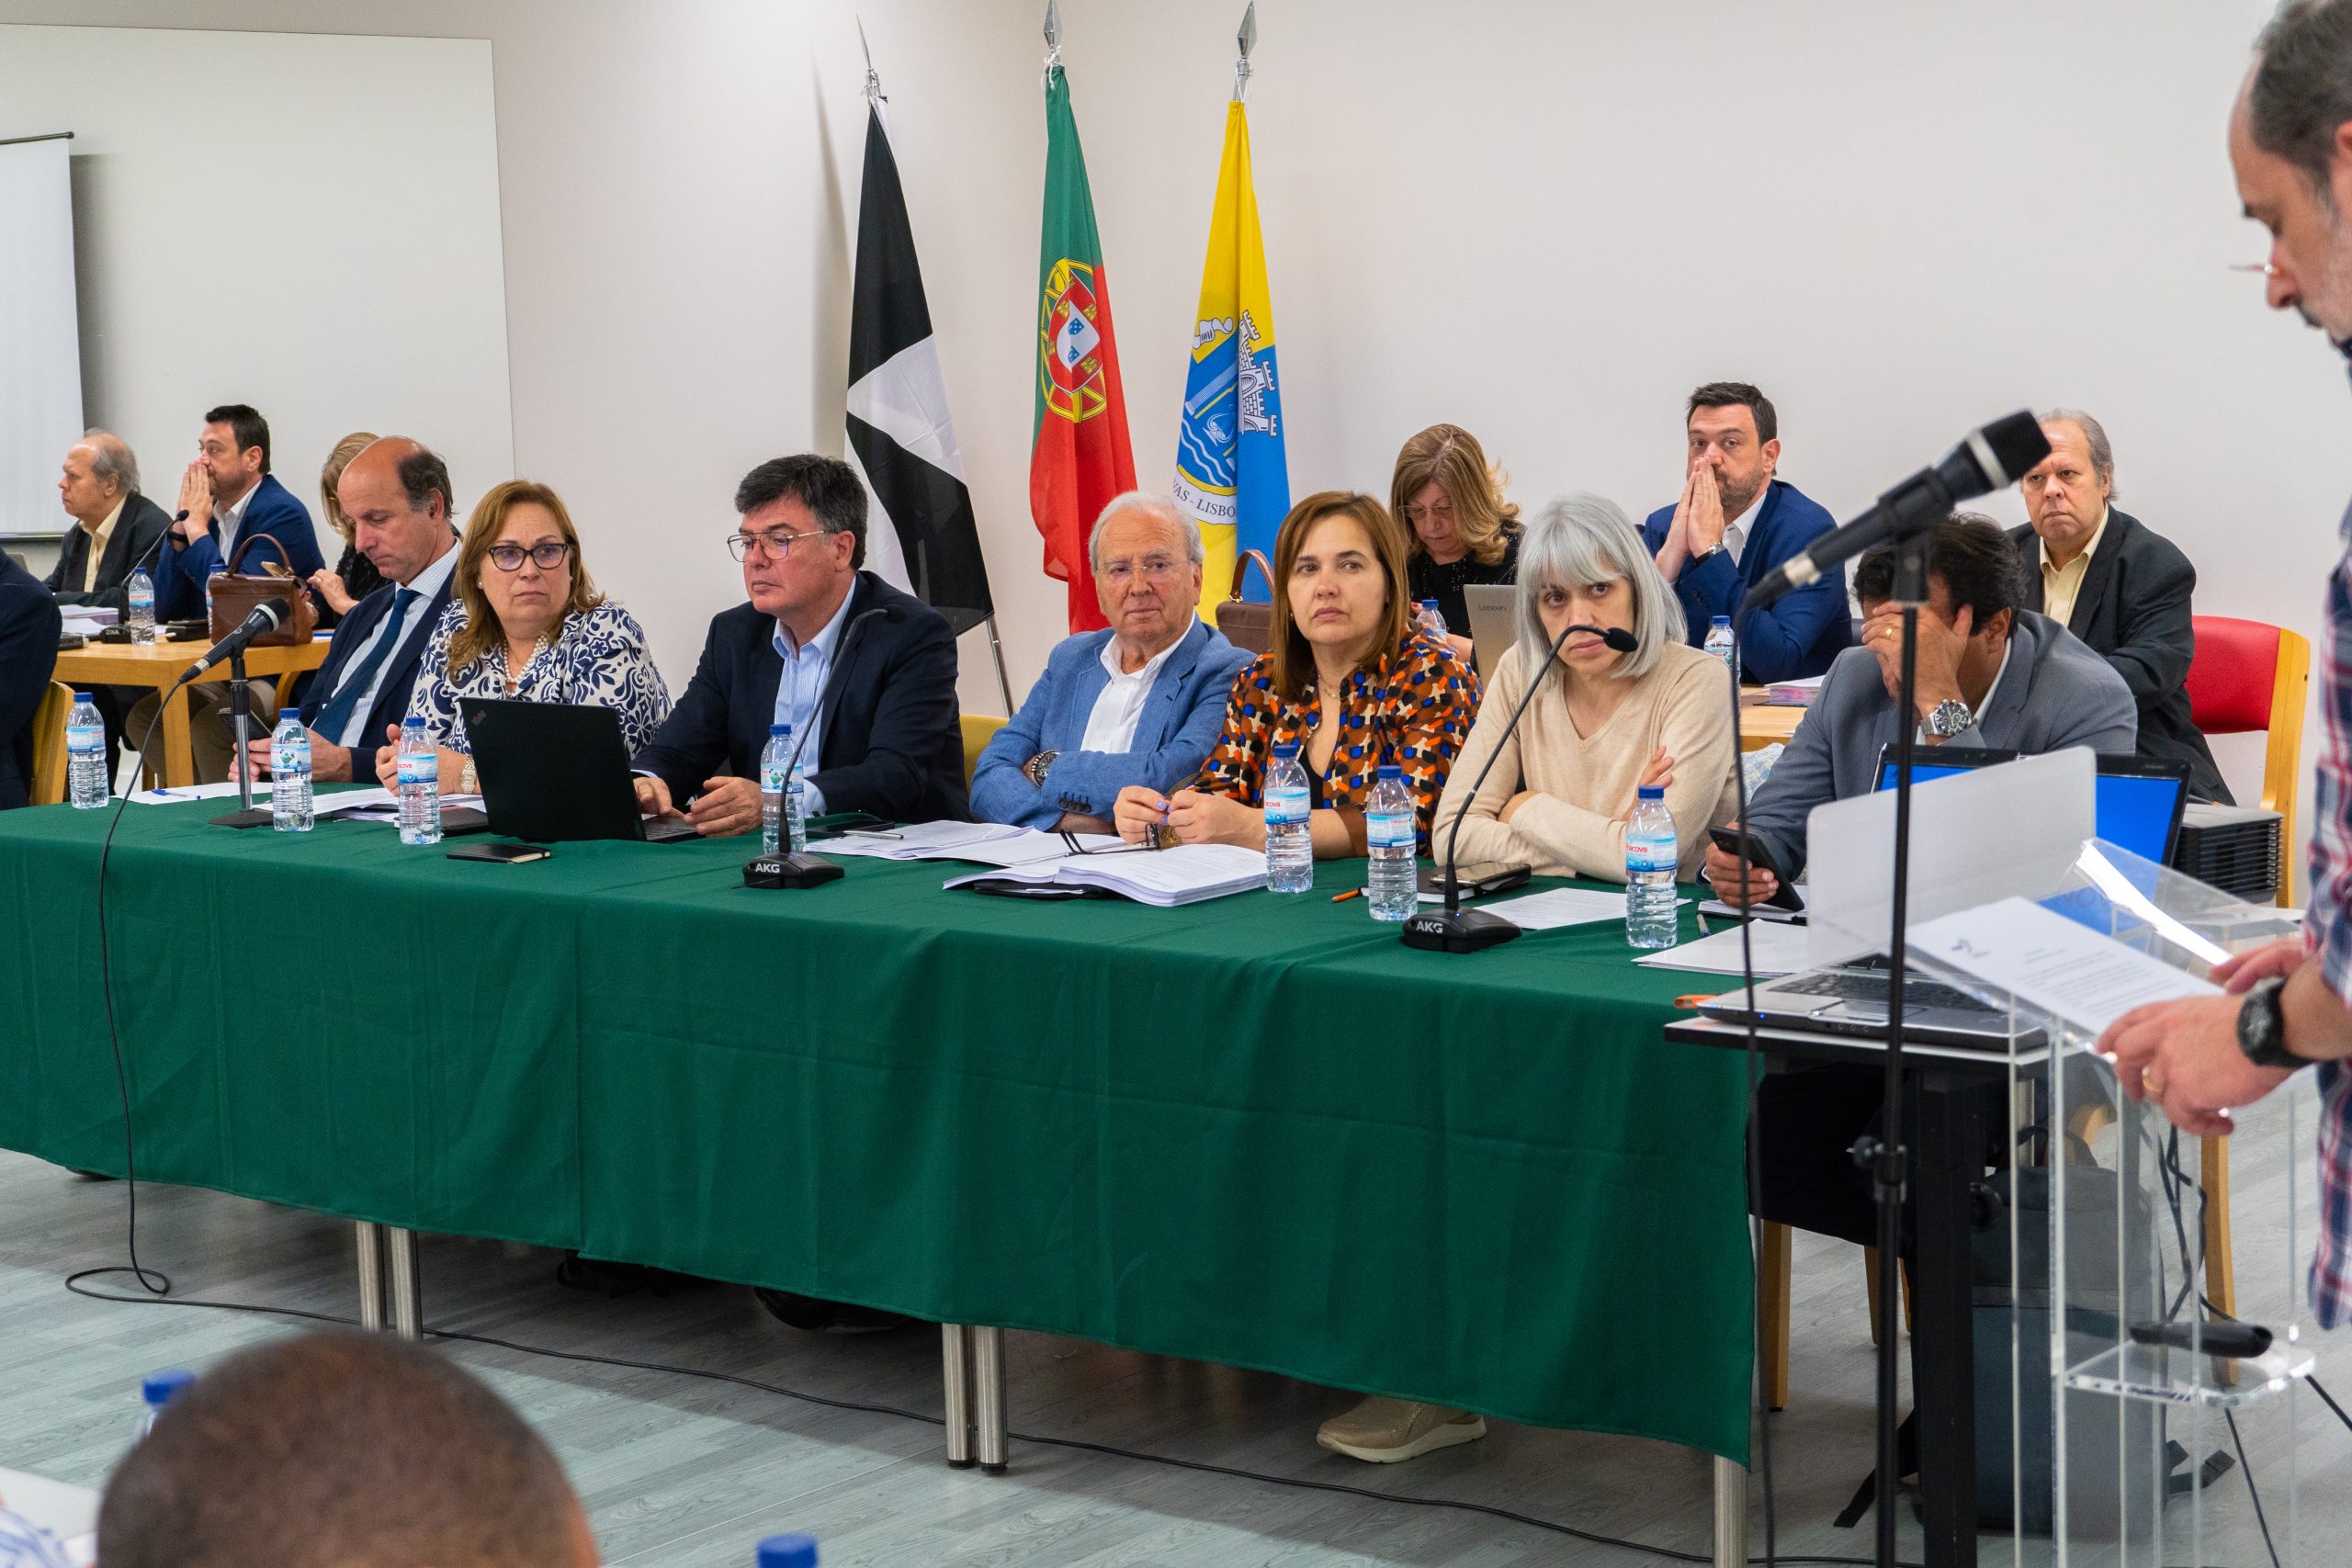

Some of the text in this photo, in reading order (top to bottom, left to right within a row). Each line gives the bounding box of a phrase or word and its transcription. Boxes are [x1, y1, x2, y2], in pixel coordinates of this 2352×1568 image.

[1196, 498, 1236, 518] LISBO
[755, 863, 781, 874] AKG
[1416, 920, 1443, 934] AKG
